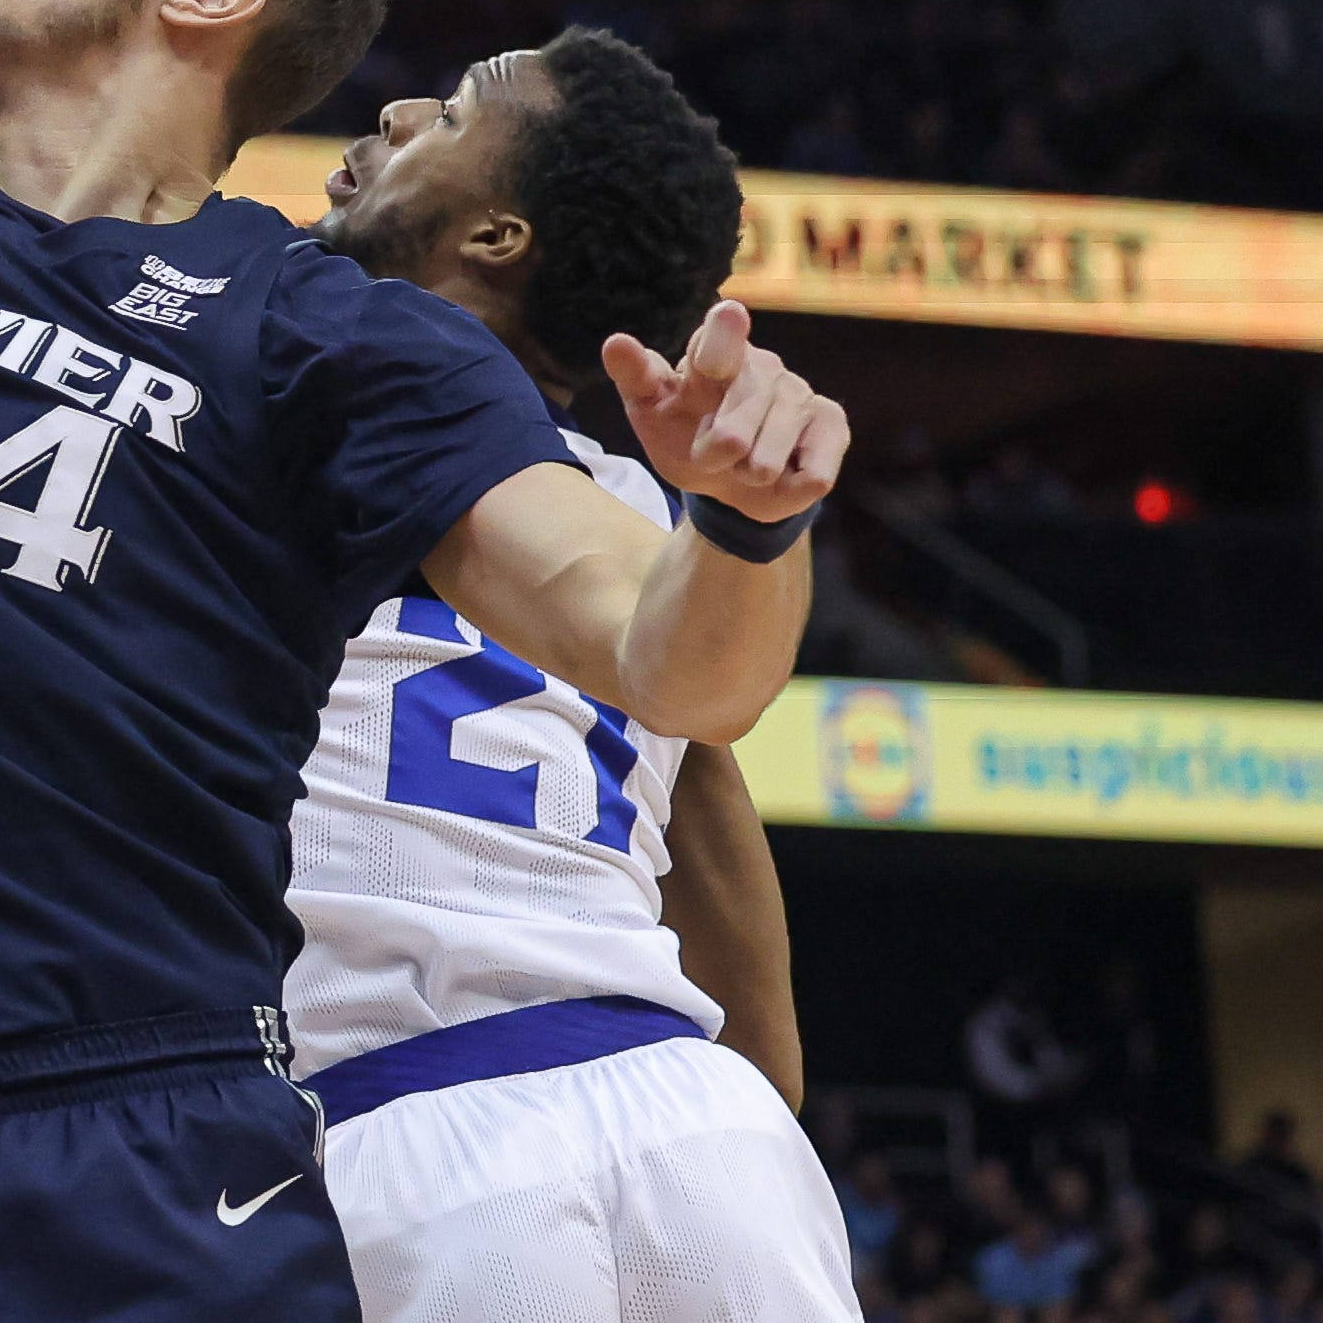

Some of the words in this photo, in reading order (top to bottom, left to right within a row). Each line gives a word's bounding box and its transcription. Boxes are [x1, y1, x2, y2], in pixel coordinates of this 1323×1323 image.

[800, 215, 1151, 301] MARKET
[114, 295, 199, 325] EAST
[128, 282, 192, 308] BIG
